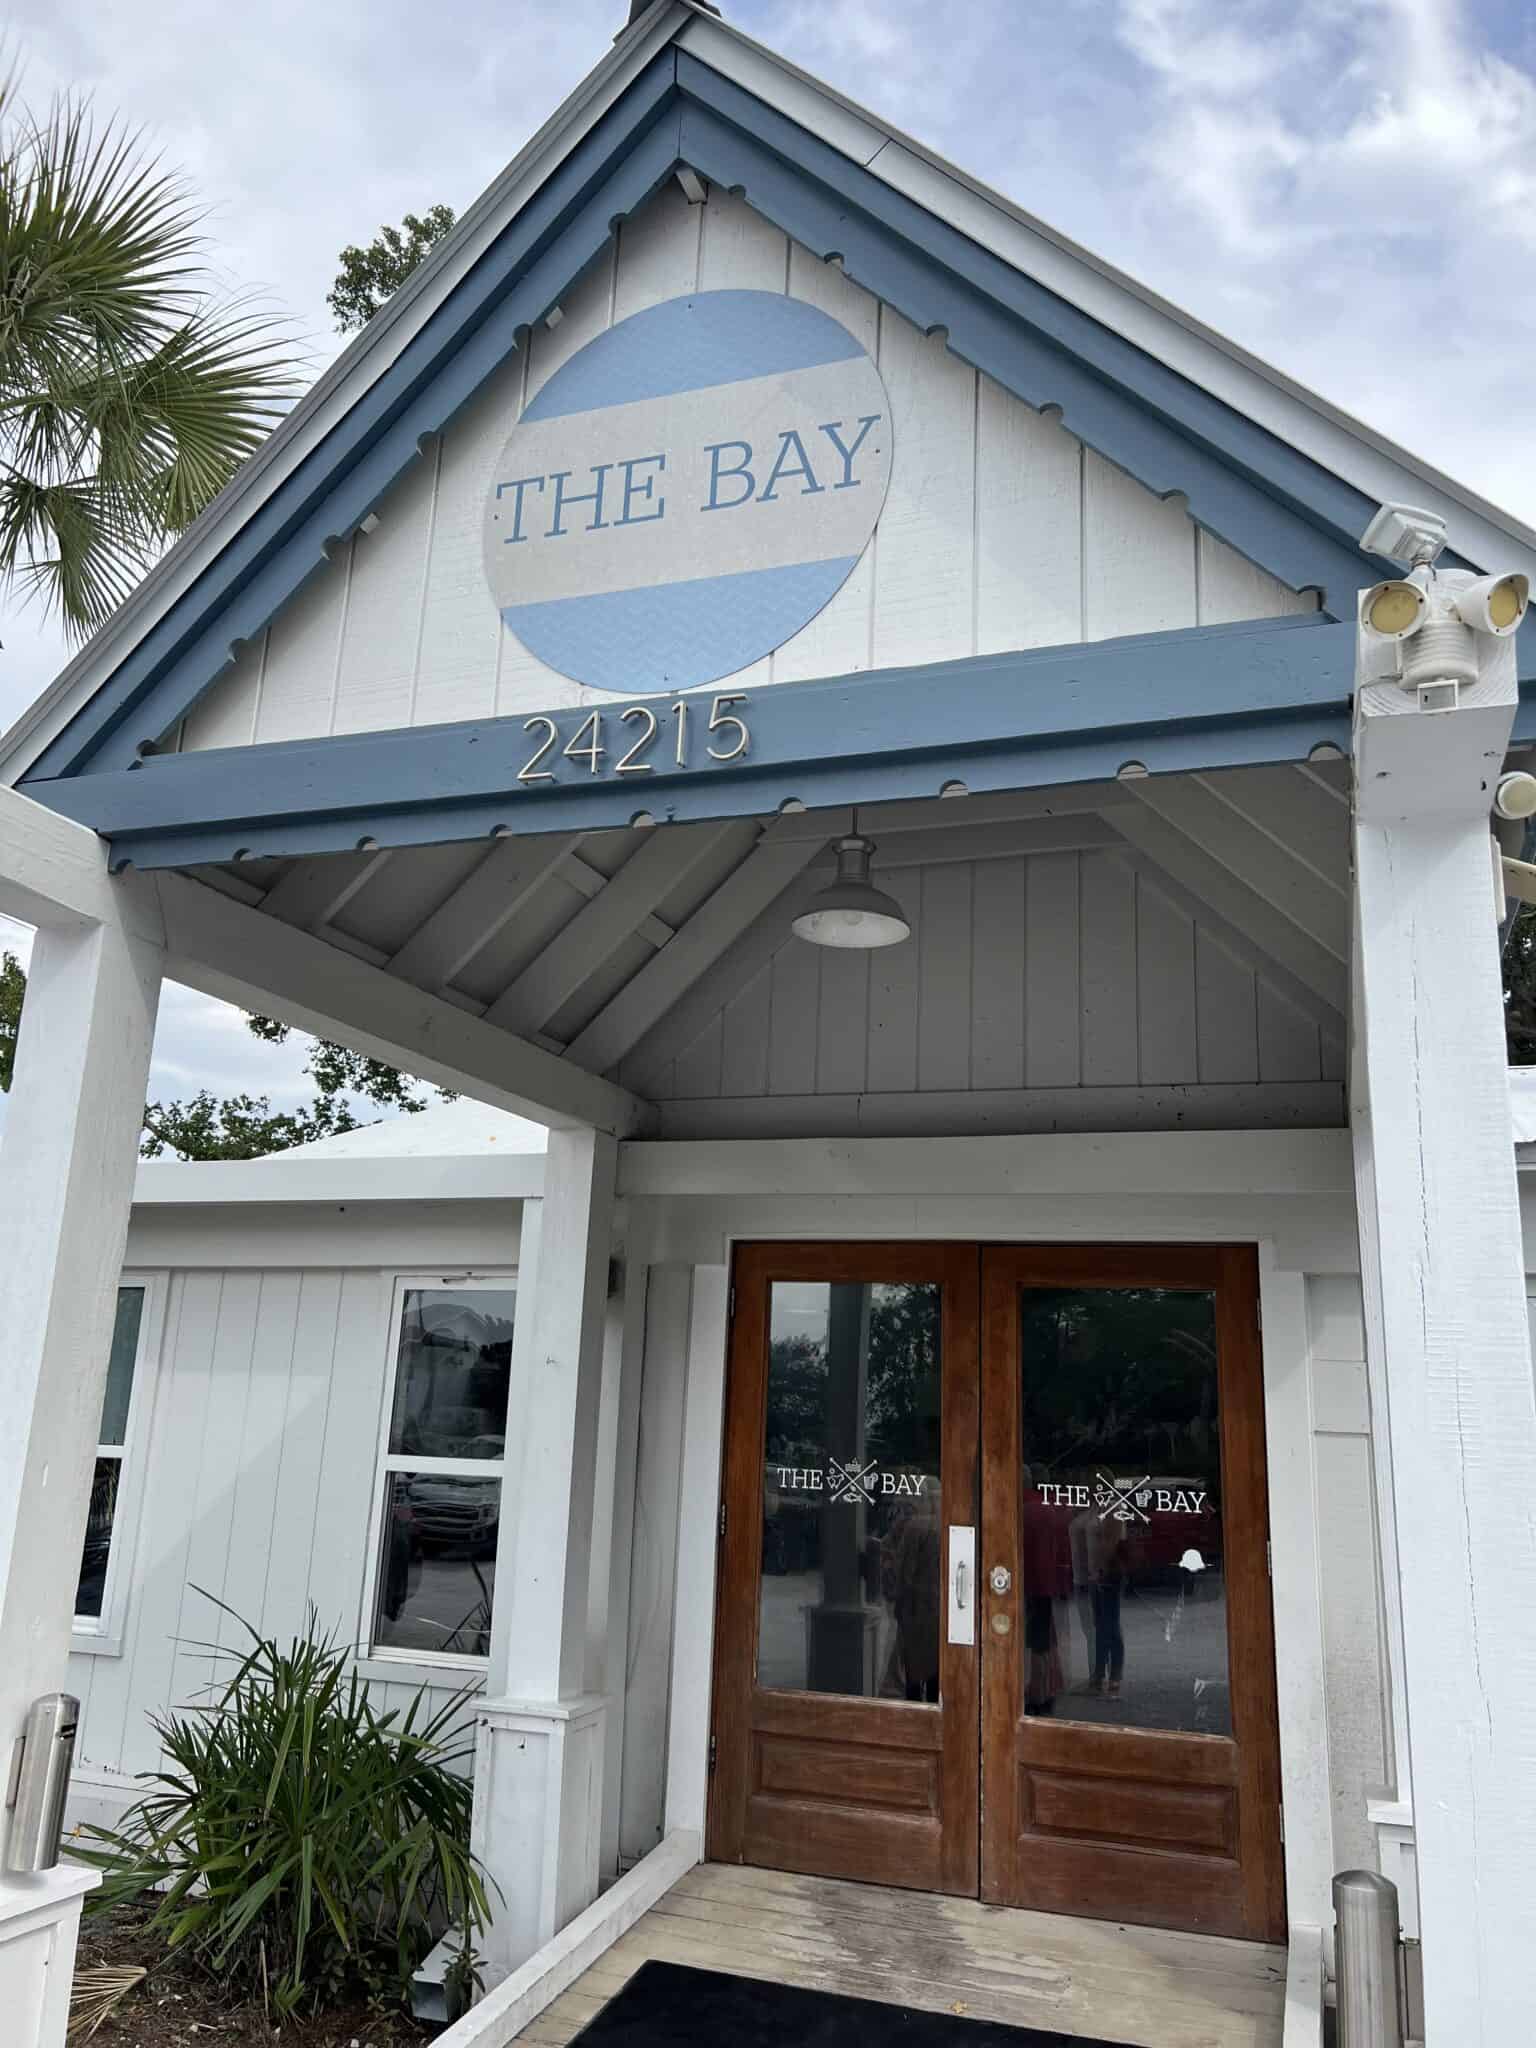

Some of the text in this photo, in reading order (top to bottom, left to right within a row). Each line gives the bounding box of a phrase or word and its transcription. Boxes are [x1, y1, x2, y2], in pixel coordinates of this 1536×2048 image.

[495, 414, 882, 545] THE BAY
[516, 693, 750, 782] 24215
[776, 1467, 928, 1496] THE BAY
[1037, 1483, 1207, 1514] THE BAY
